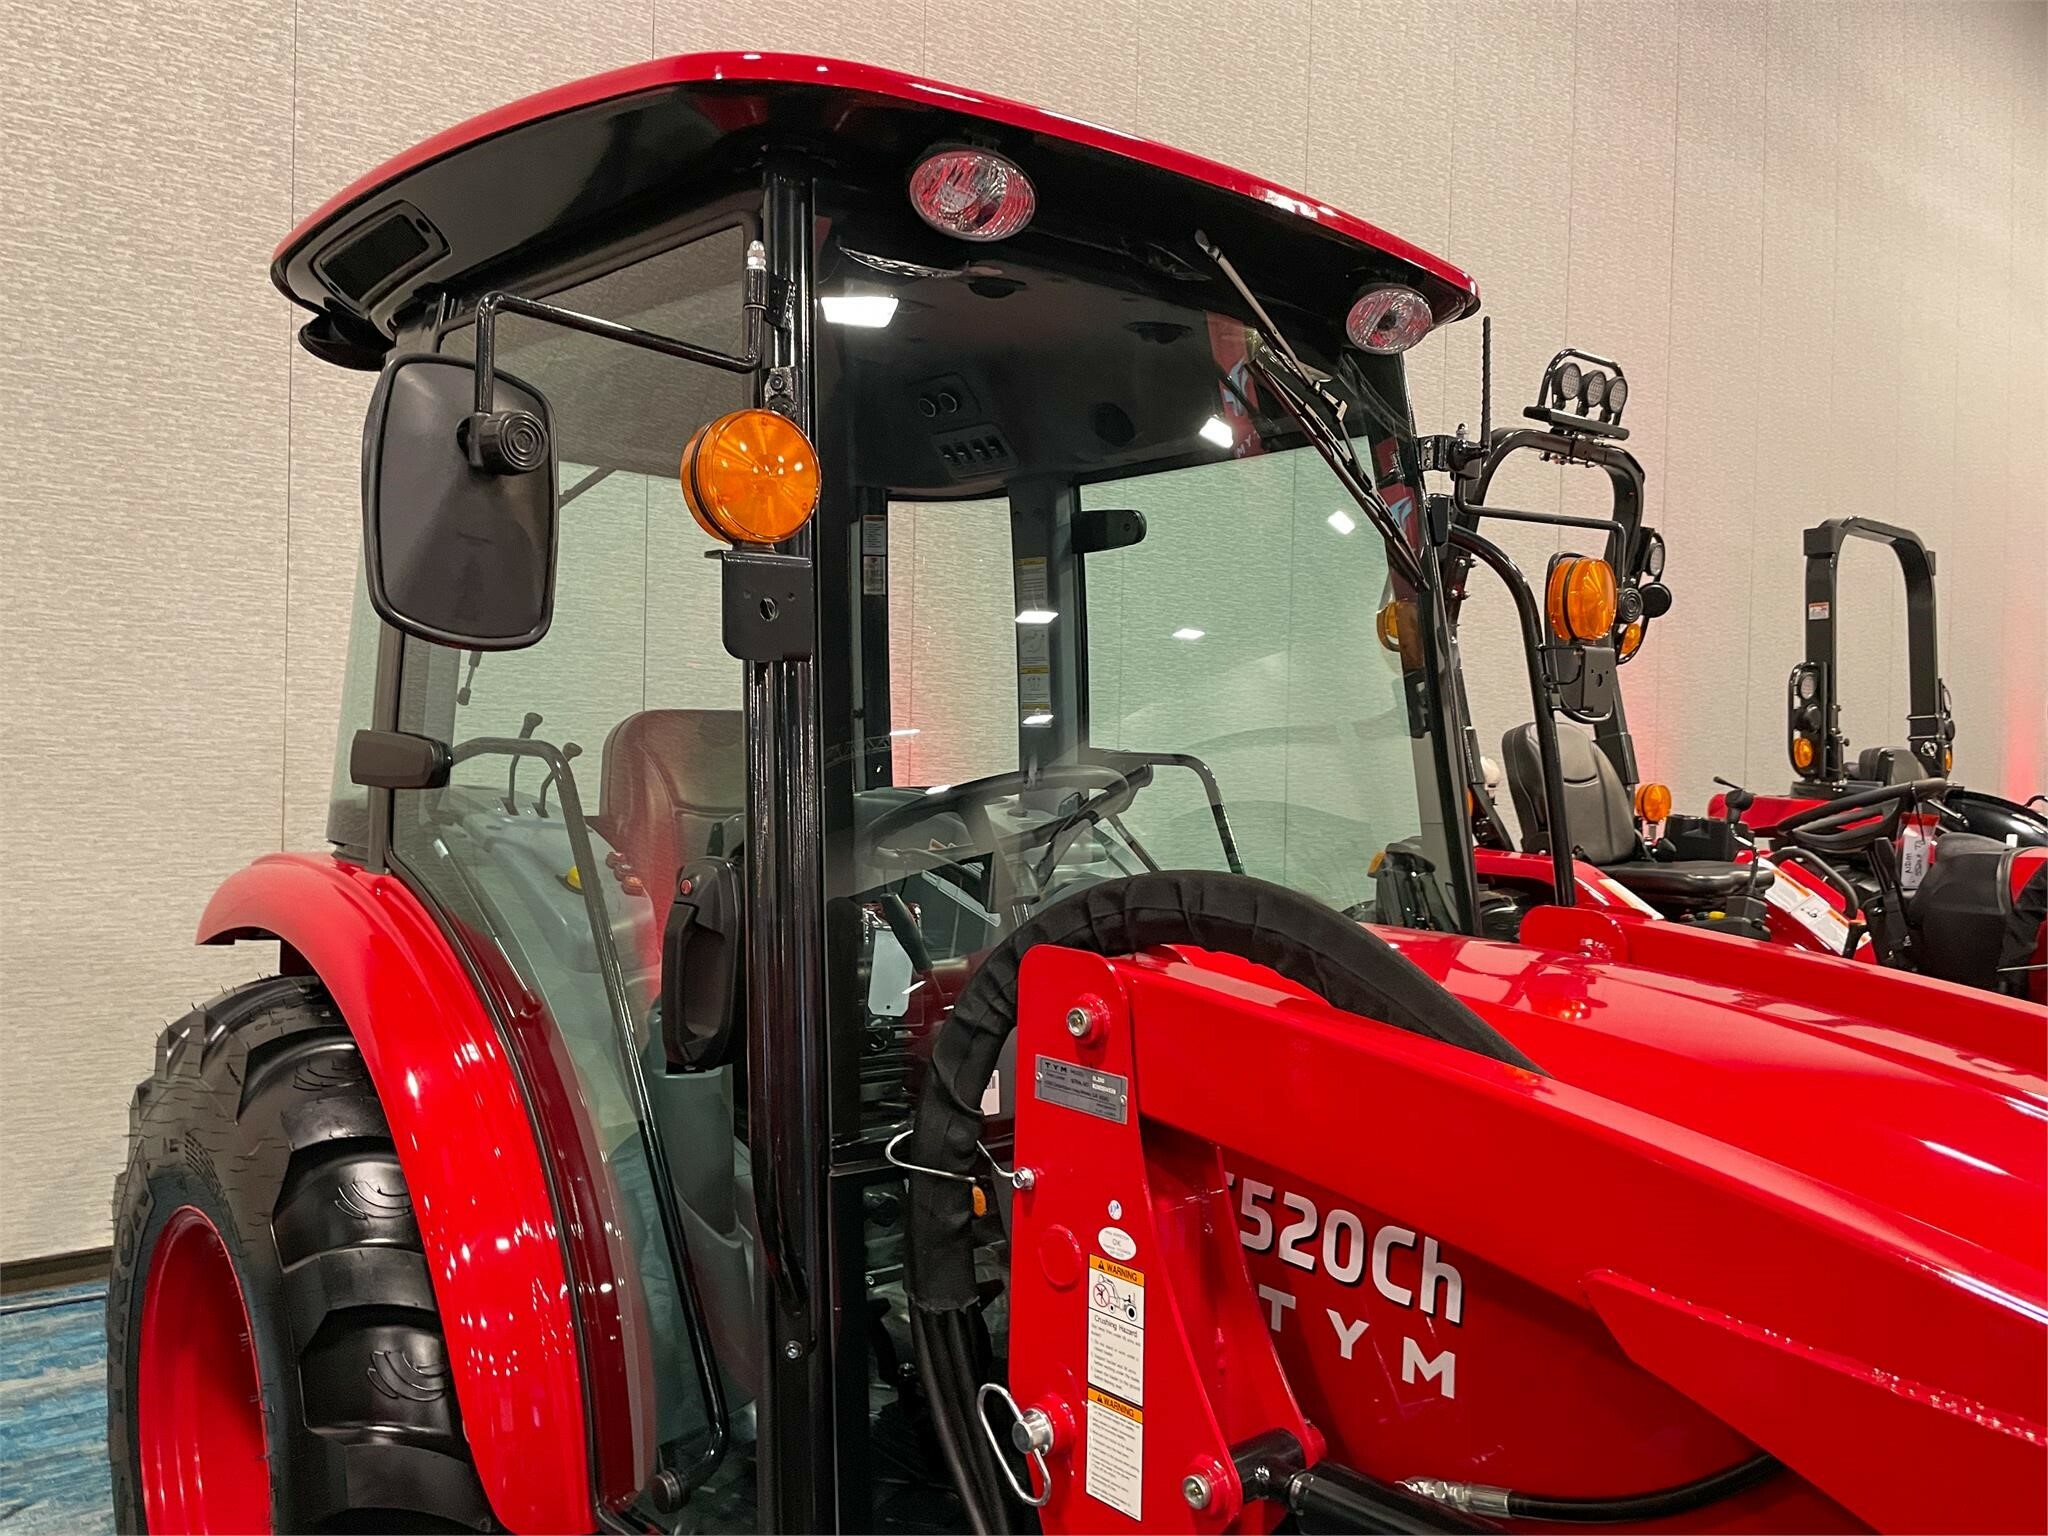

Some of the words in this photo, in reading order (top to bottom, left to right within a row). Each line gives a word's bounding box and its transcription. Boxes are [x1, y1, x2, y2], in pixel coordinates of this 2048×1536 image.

[1045, 1062, 1067, 1073] TYM
[1224, 1171, 1462, 1324] 520Ch
[1106, 1263, 1138, 1282] WARNING
[1094, 1314, 1118, 1331] Crushing
[1258, 1283, 1456, 1400] TYM
[1103, 1395, 1135, 1418] WARNING
